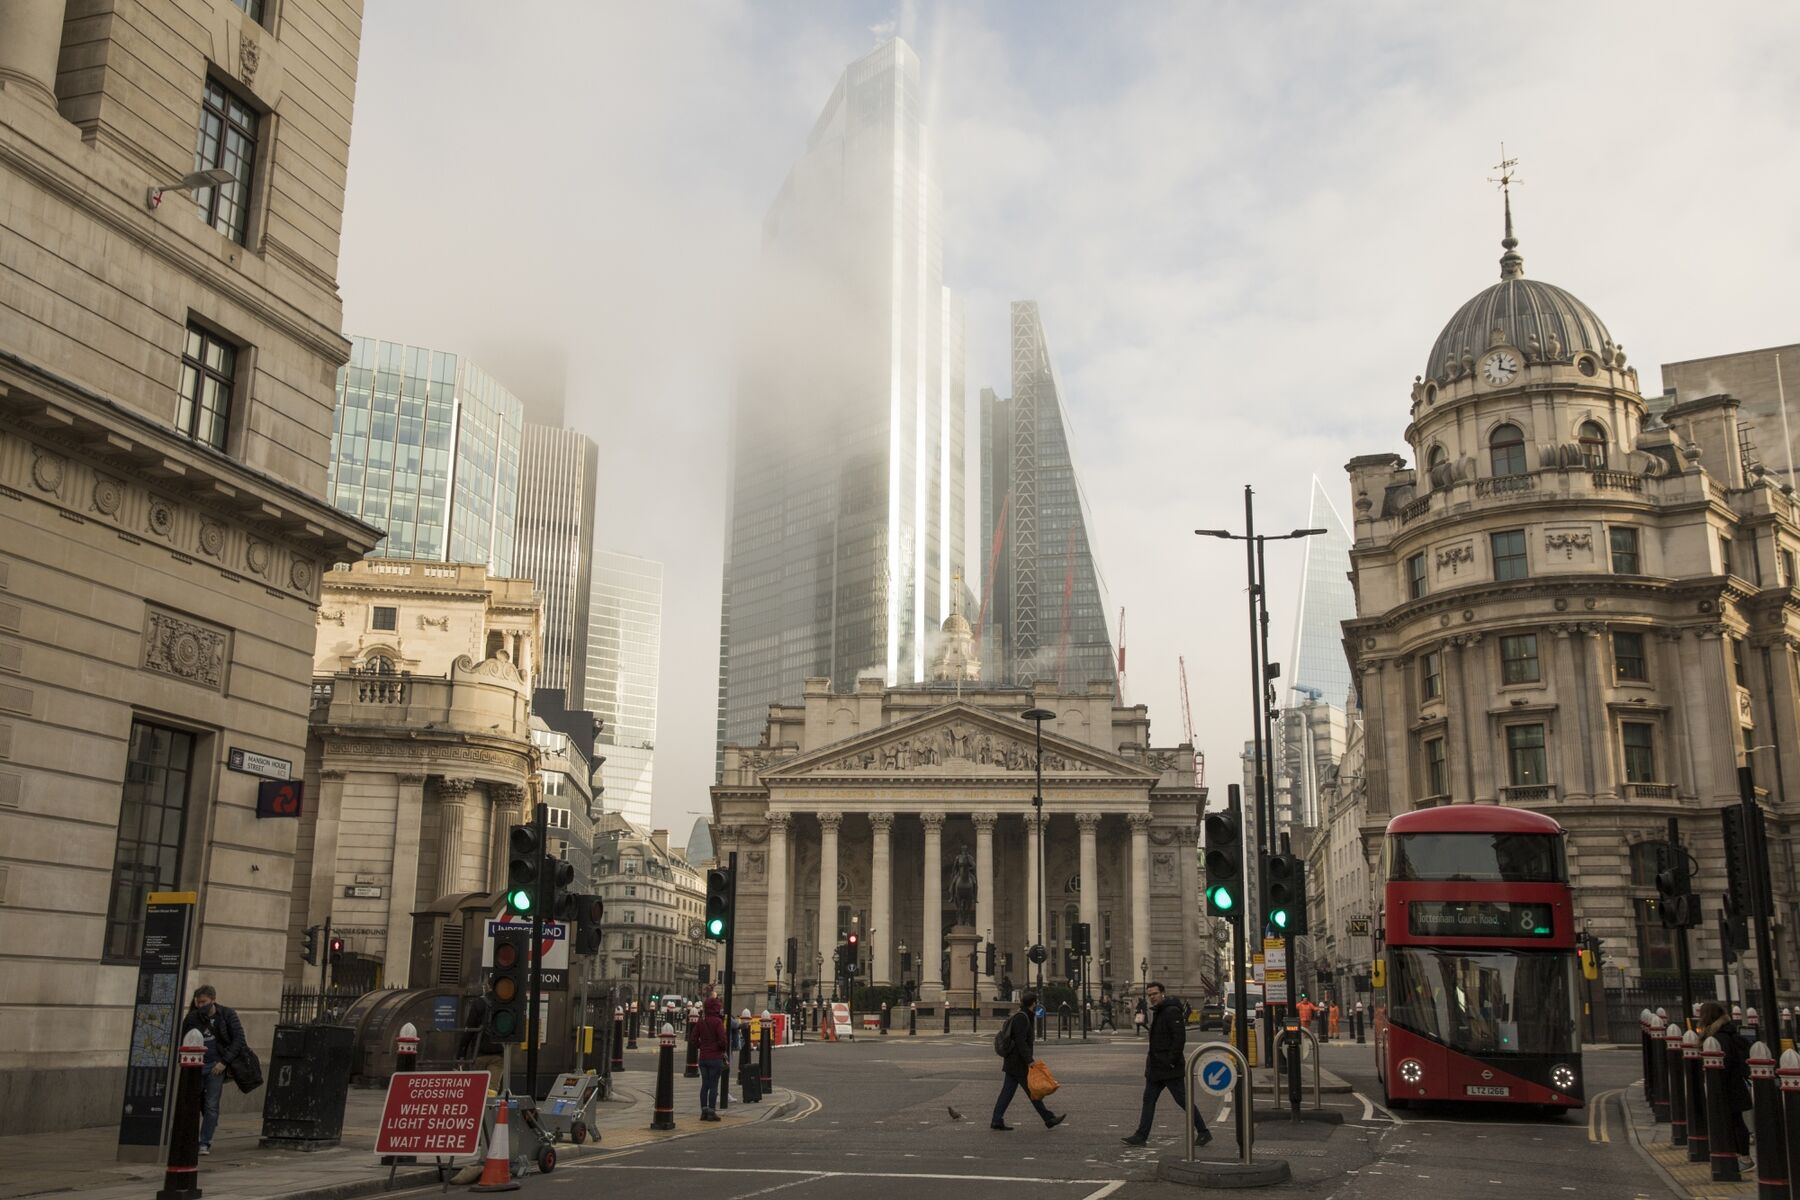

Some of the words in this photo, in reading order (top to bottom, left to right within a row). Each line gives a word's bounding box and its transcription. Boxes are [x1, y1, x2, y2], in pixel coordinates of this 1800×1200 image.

[247, 755, 271, 766] MANSION
[271, 760, 287, 770] HOUSE
[247, 763, 265, 772] STREET
[1418, 912, 1455, 923] Tottenham
[1457, 913, 1477, 924] Court
[1520, 910, 1534, 930] 8
[408, 1078, 471, 1088] PEDESTRIAN
[410, 1089, 464, 1099] CROSSING
[400, 1104, 438, 1115] WHEN
[442, 1104, 468, 1115] RED
[387, 1118, 424, 1129] LIGHT
[427, 1118, 475, 1130] SHOWS
[389, 1136, 421, 1148] WAIT
[424, 1134, 467, 1149] HERE
